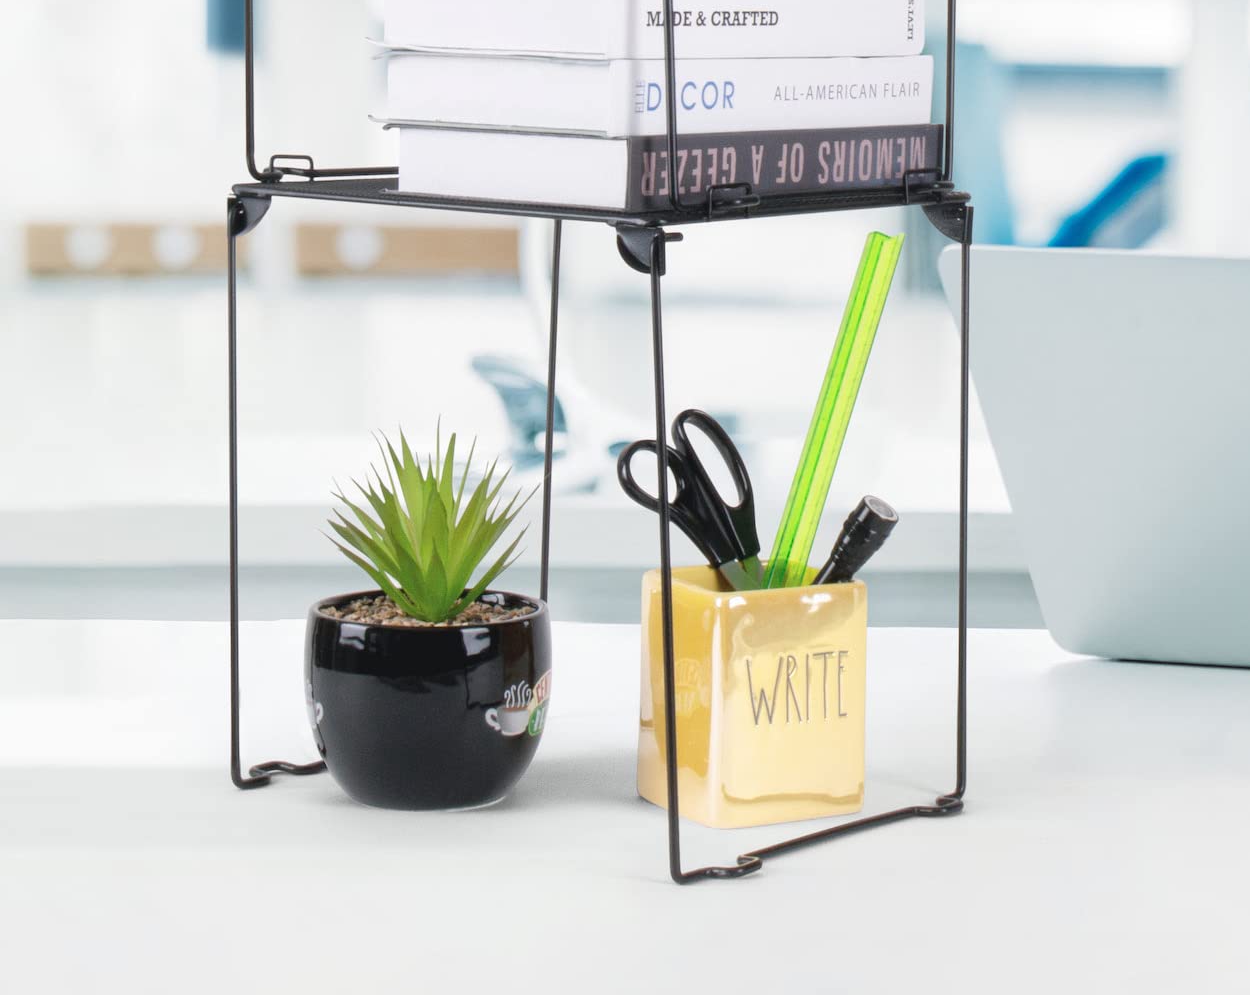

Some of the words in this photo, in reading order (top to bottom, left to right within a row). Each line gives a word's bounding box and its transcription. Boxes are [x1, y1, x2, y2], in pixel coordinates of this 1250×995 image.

[646, 11, 692, 27] MDE
[695, 11, 707, 27] &
[711, 11, 779, 26] CRAFTED
[646, 81, 735, 111] DCOR
[774, 83, 877, 101] ALL-AMERICAN
[883, 82, 920, 98] FLAIR
[641, 146, 737, 197] GEEZER
[751, 145, 765, 185] A
[776, 143, 805, 184] OF
[818, 136, 927, 184] MEMOIRS
[746, 650, 848, 725] WRITE
